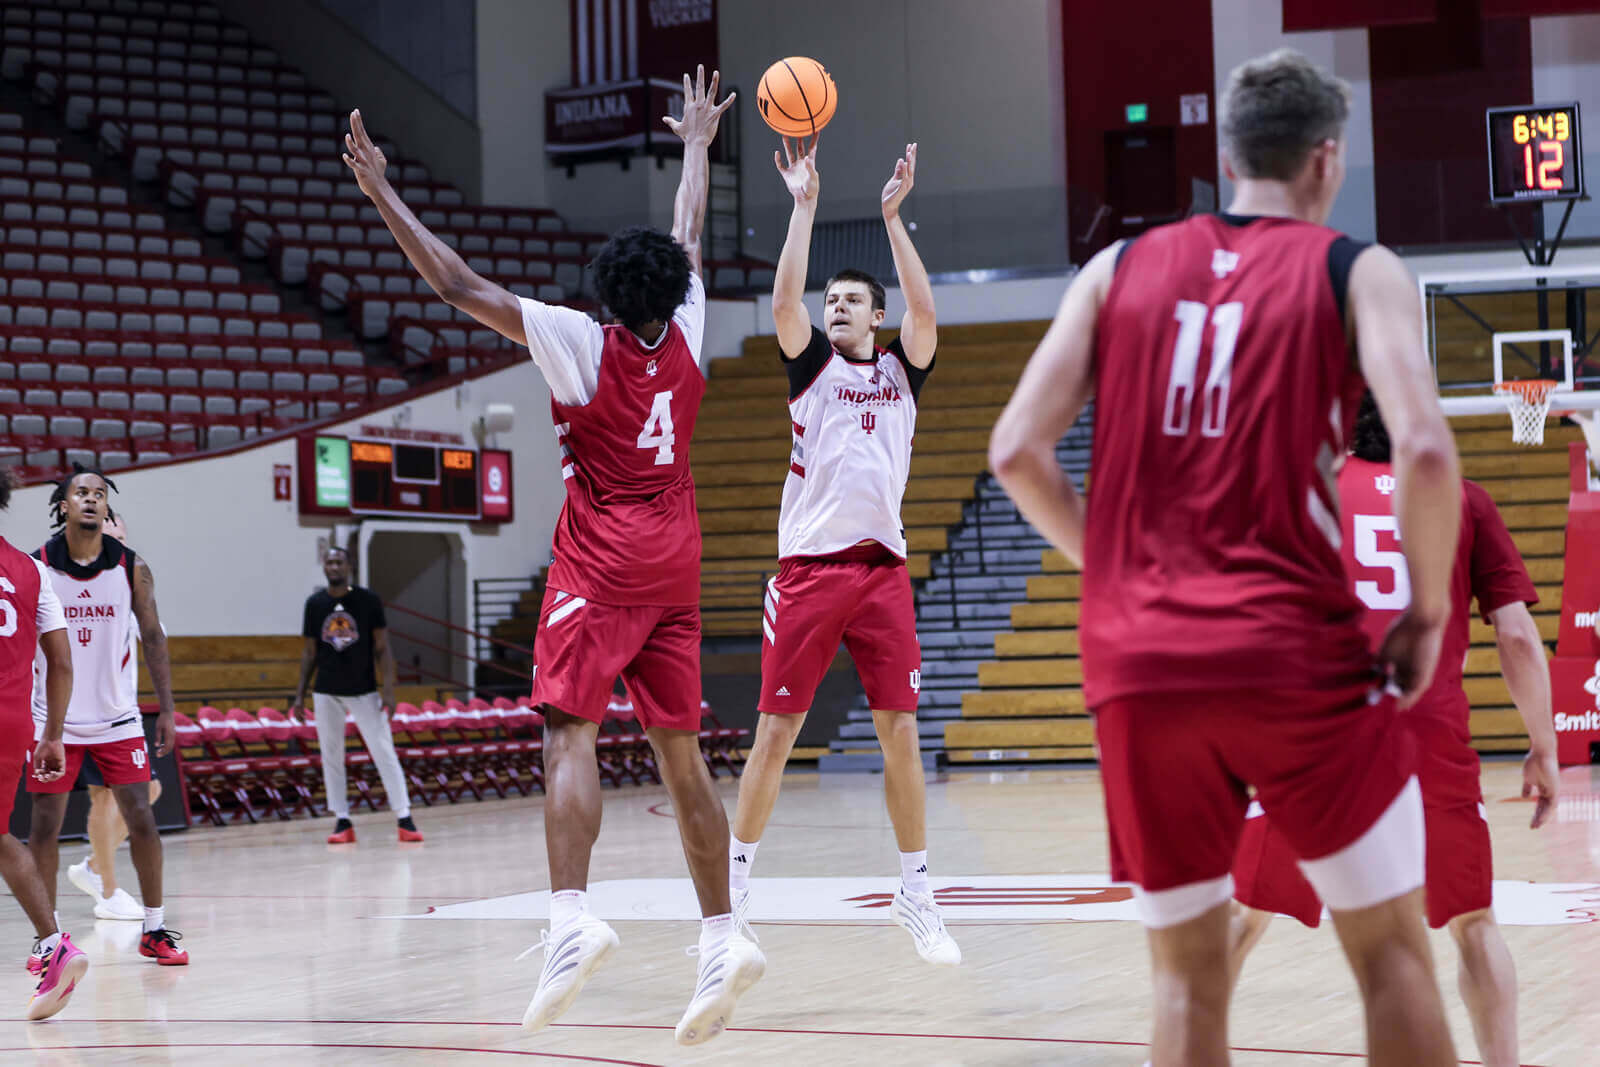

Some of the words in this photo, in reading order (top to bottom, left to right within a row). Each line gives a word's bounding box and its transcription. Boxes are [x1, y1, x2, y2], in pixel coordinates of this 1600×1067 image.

[554, 94, 632, 125] INDIANA
[1513, 112, 1569, 144] 6:43
[1524, 141, 1563, 190] 12
[1163, 300, 1243, 437] 11
[838, 387, 902, 404] INDIANA
[637, 391, 675, 465] 4
[1354, 514, 1411, 610] 5
[64, 606, 115, 618] DIANA
[1555, 711, 1600, 732] Smit
